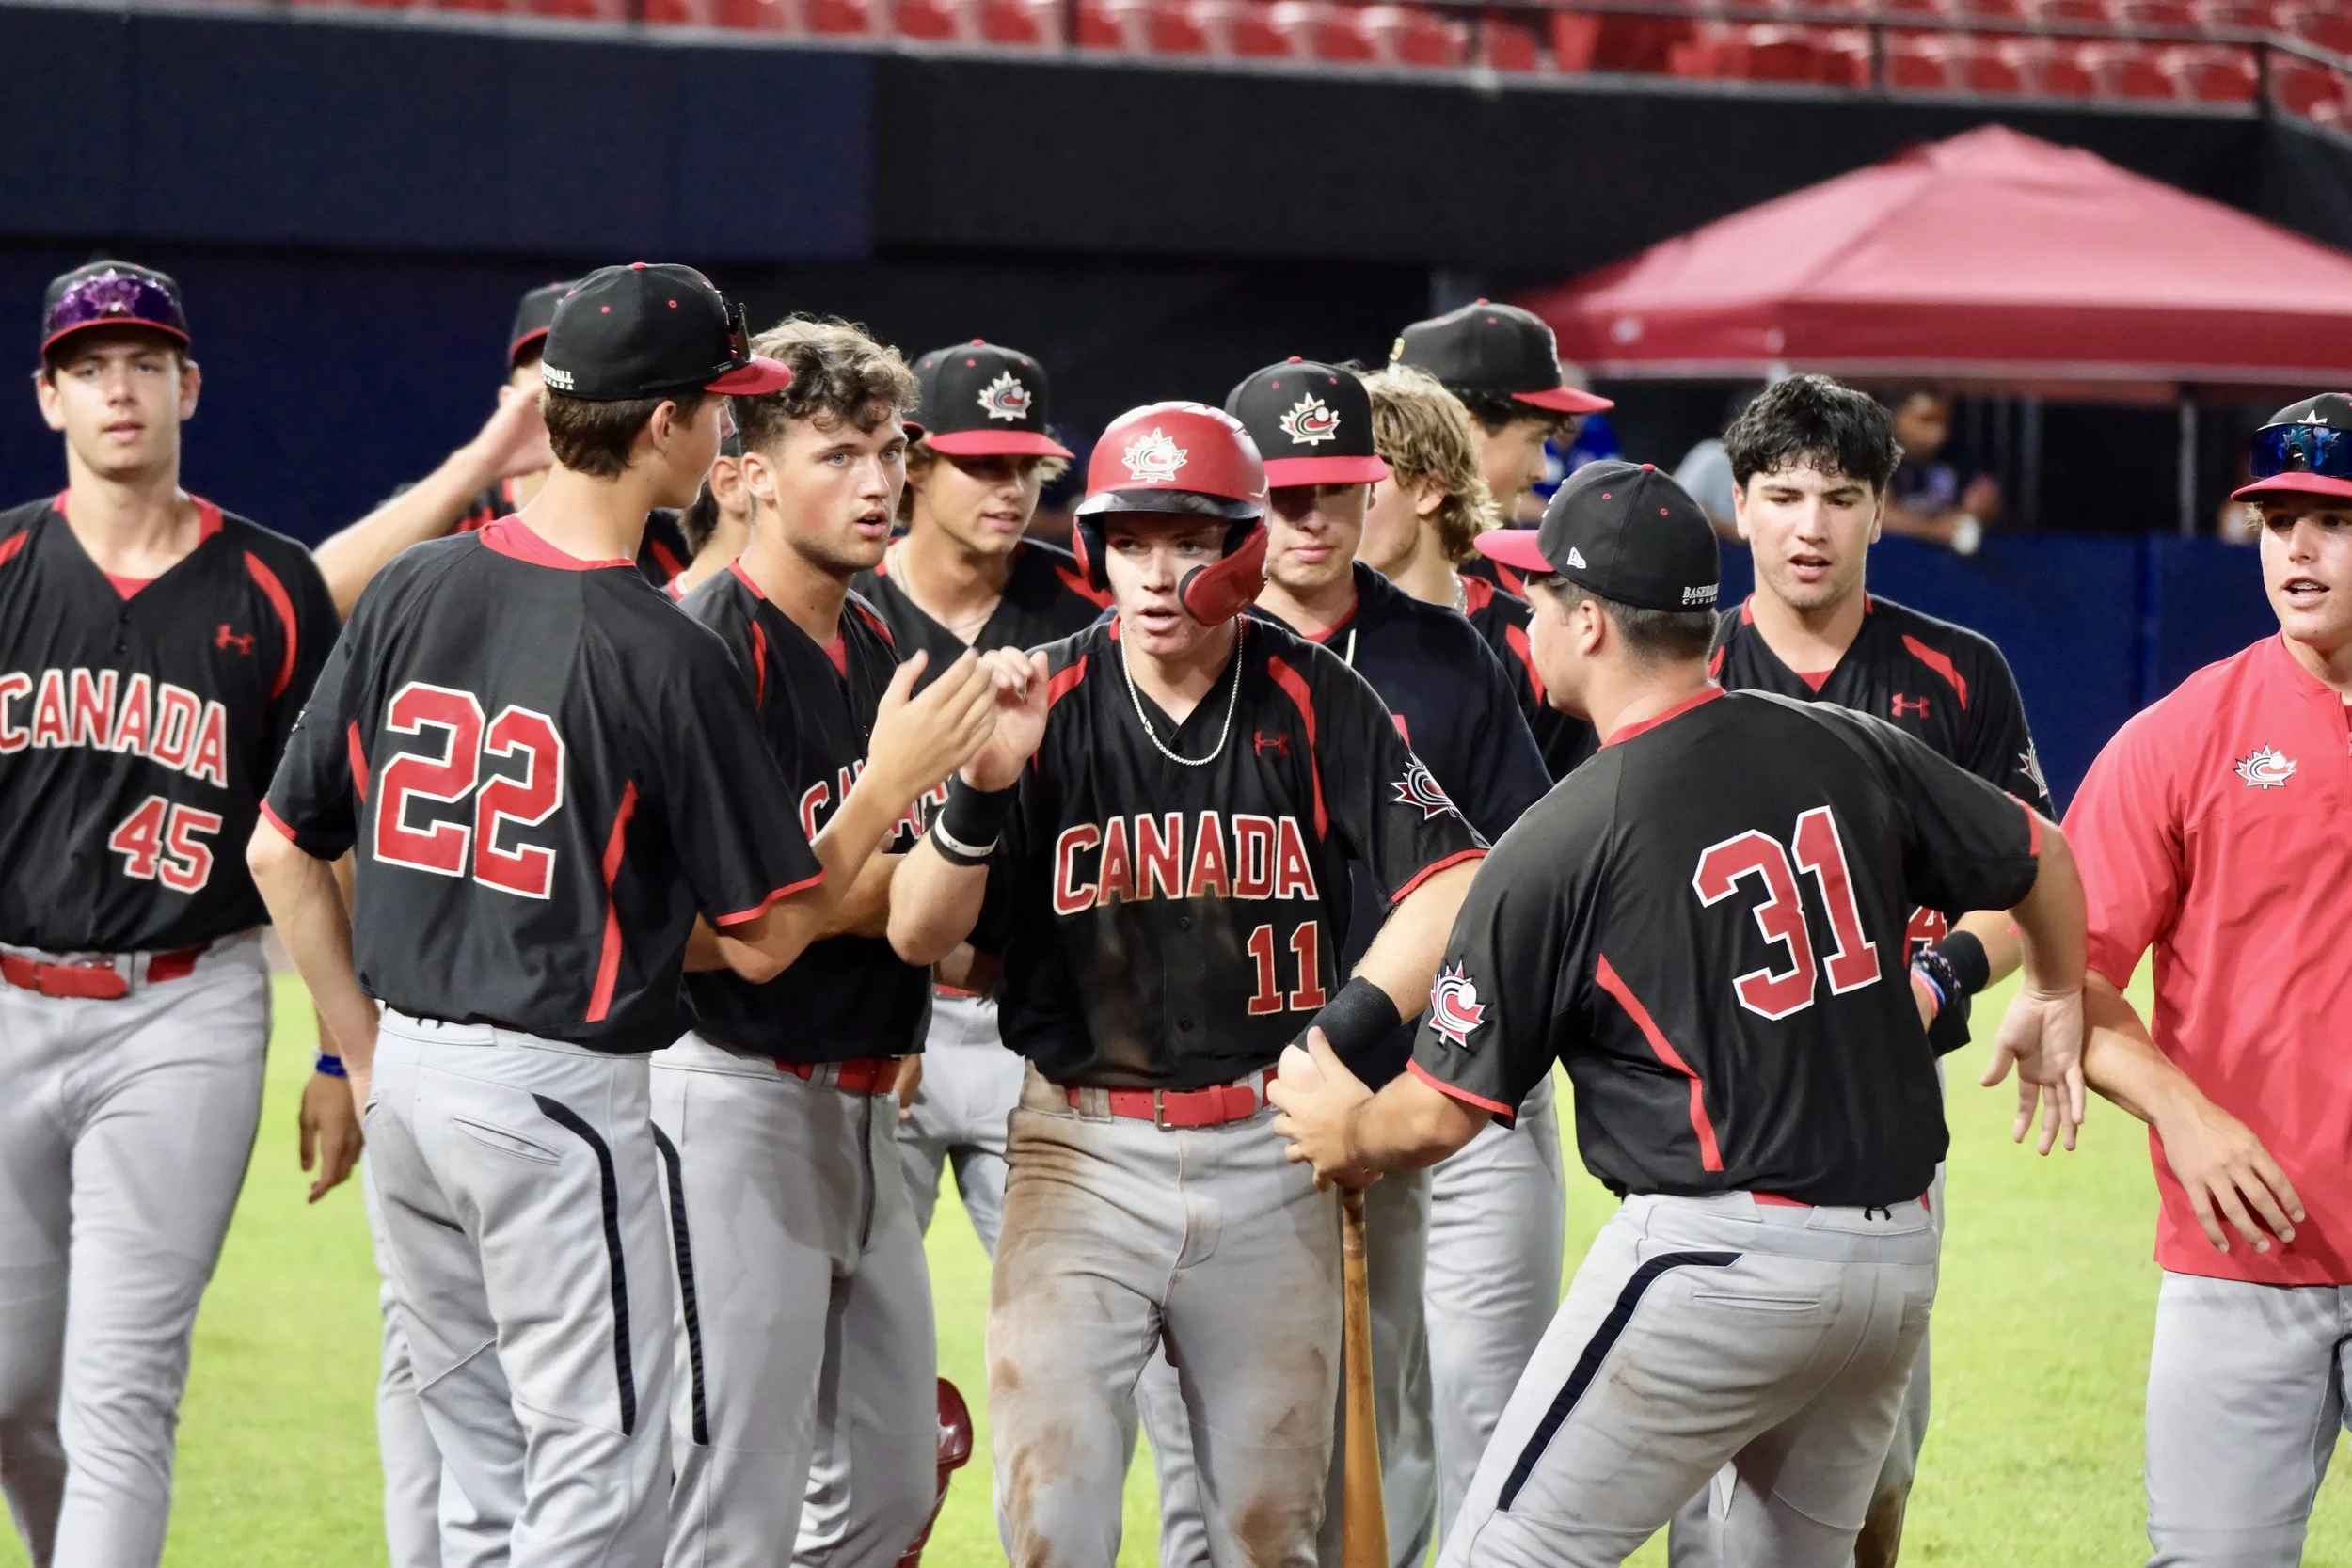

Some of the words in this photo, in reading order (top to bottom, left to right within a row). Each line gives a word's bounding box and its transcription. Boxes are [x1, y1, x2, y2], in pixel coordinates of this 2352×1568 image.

[0, 667, 228, 789] CANADA
[108, 795, 223, 894] 45
[373, 681, 565, 900] 22
[1053, 810, 1319, 916] CANADA
[1692, 805, 1883, 1021] 31
[1248, 920, 1326, 1016] 11
